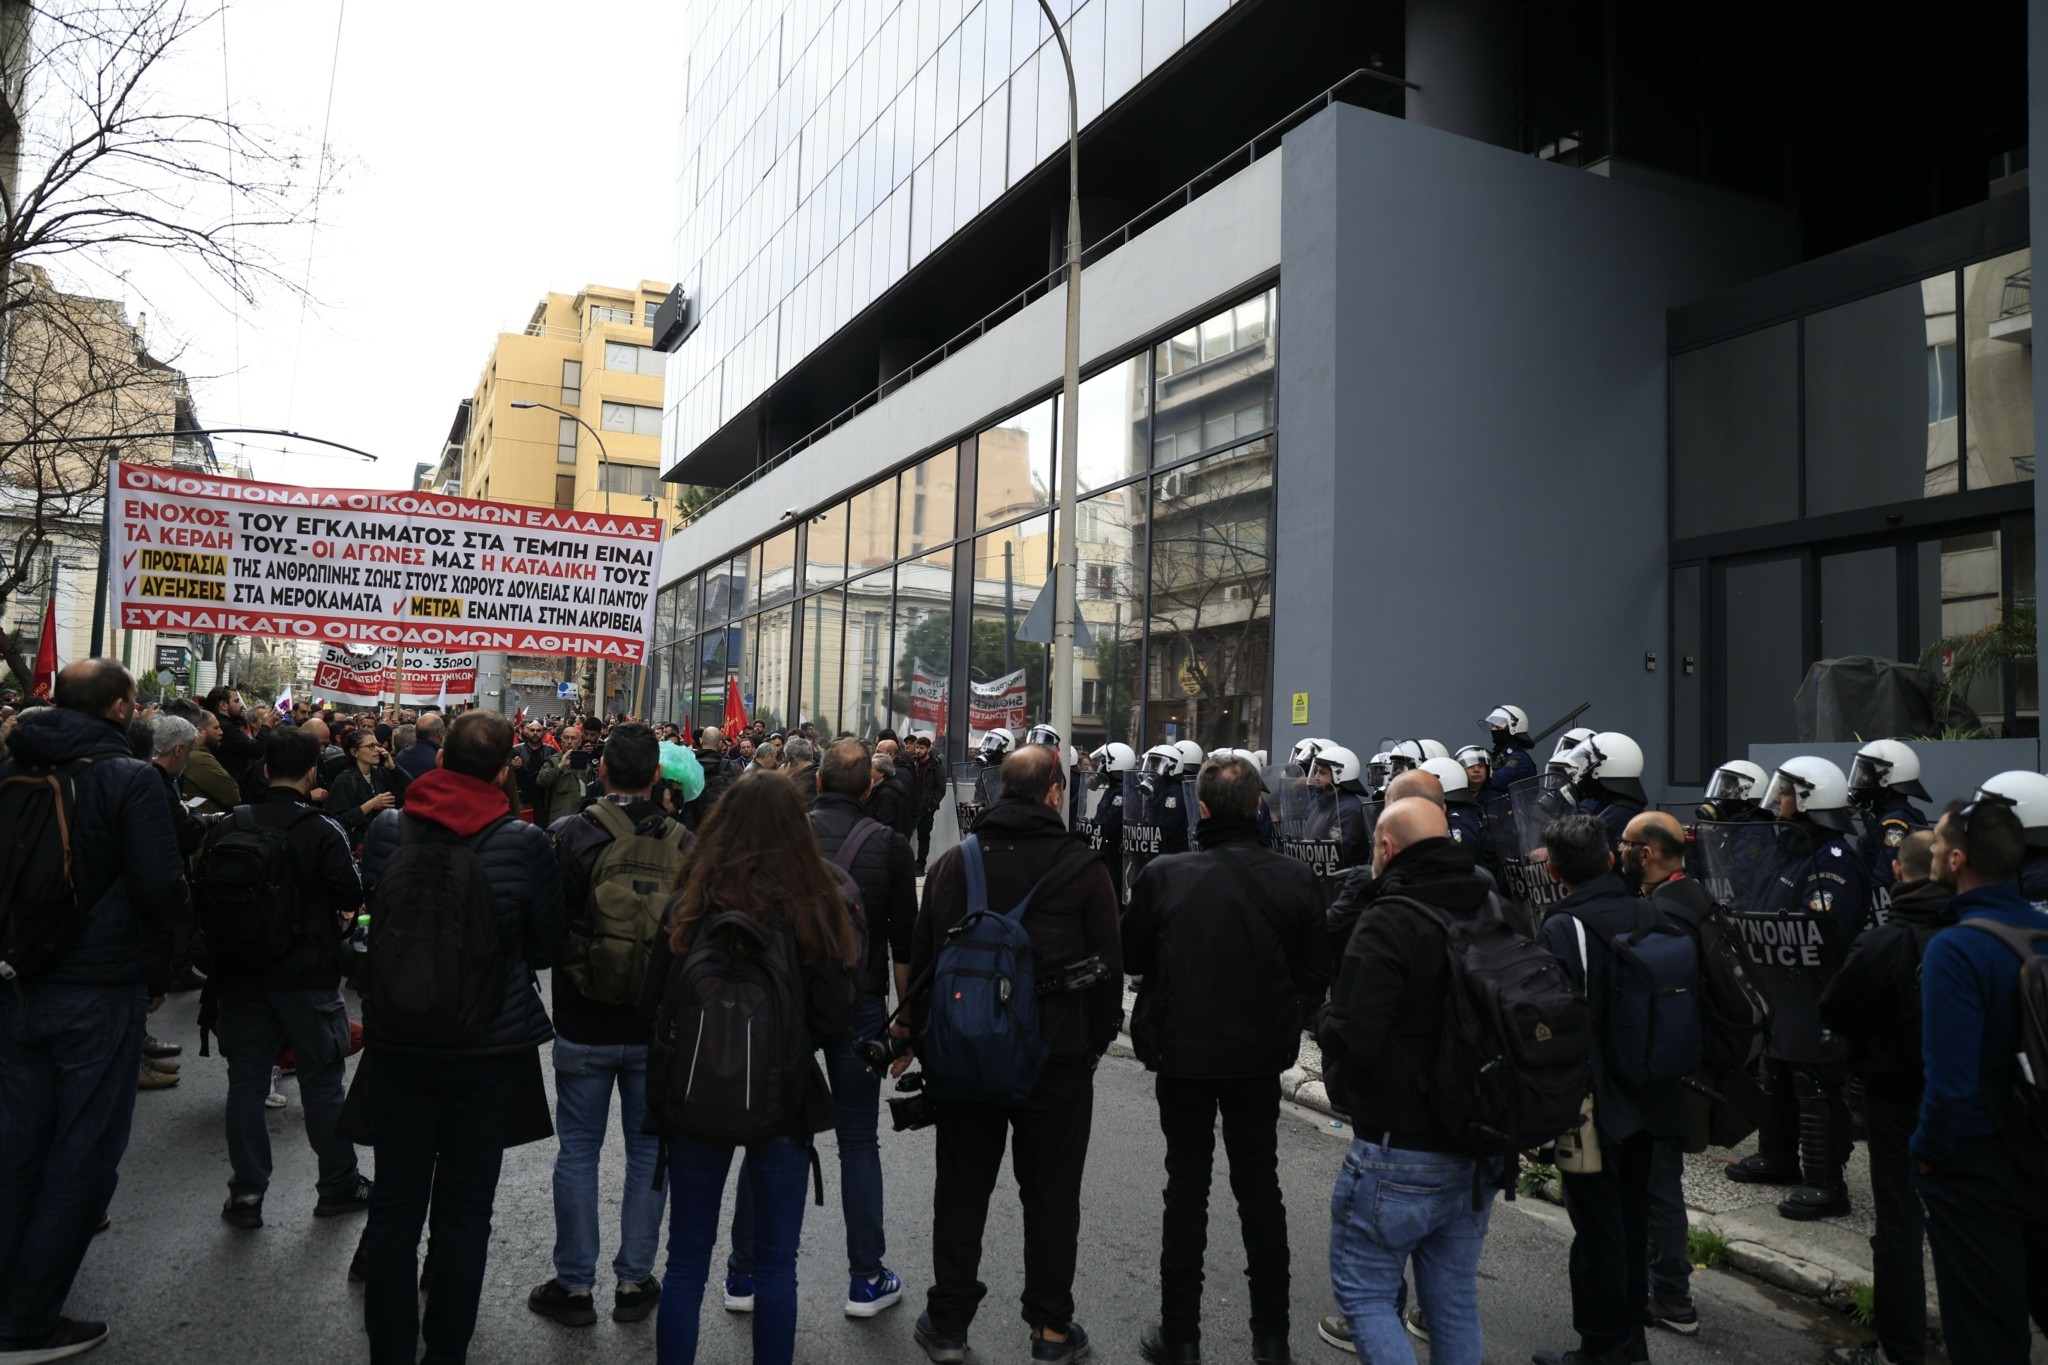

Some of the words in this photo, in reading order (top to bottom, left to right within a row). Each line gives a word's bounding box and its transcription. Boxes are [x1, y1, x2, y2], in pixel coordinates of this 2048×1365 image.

[124, 500, 230, 528] ΕΝΟΧΟΣ
[238, 512, 289, 533] ΤΟΥ
[296, 517, 456, 547] ΕΓΚΛΗΜΑΤΟΣ
[462, 532, 505, 551] ΣΤΑ
[513, 536, 588, 560] ΤΕΜΠΗ
[595, 545, 654, 567] ΕΙΝΑΙ
[126, 471, 341, 509] ΟΜΟΣΠΟΝΔΙΑ
[347, 493, 521, 525] ΟΙΚΟΔΟΜΩΝ
[526, 511, 656, 540] ΕΛΛΑΔΑΣ
[124, 523, 151, 543] ΤΑ
[160, 527, 233, 550] ΚΕΡΔΗ
[241, 534, 297, 555] ΤΟΥΣ
[312, 540, 334, 559] ΟΙ
[342, 542, 426, 566] ΑΓΩΝΕΣ
[432, 550, 475, 570] ΜΑΣ
[481, 554, 495, 572] Η
[501, 556, 597, 581] ΚΑΤΑΔΙΚΗ
[603, 566, 651, 587] ΤΟΥΣ
[141, 552, 226, 577] ΠΡΟΣΤΑΣΙΑ
[233, 557, 261, 578] ΤΗΣ
[265, 559, 360, 588] ΑΝΘΡΩΠΙΝΗΣ
[364, 567, 402, 590] ΖΩΗΣ
[405, 573, 448, 593] ΣΤΟΥΣ
[452, 575, 504, 597] ΧΩΡΟΥΣ
[507, 579, 570, 602] ΔΟΥΛΕΙΑΣ
[573, 585, 596, 606] ΚΑΙ
[599, 588, 648, 611] ΠΑΝΤΟΥ
[126, 608, 317, 636] ΣΥΝΔΙΚΑΤΟ
[323, 622, 513, 648] ΟΙΚΟΔΟΜΩΝ
[518, 635, 641, 660] ΑΘΗΝΑΣ
[141, 579, 226, 601] ΑΥΞΗΣΕΙΣ
[233, 584, 264, 604] ΣΤΑ
[270, 587, 382, 613] ΜΕΡΟΚΑΜΑΤΑ
[411, 599, 460, 619] ΜΕΤΡΑ
[467, 602, 533, 623] ΕΝΑΝΤΙΑ
[538, 607, 577, 627] ΣΤΗΝ
[579, 610, 643, 634] ΑΚΡΙΒΕΙΑ
[1122, 839, 1160, 853] OLICE
[1746, 944, 1822, 967] LICE
